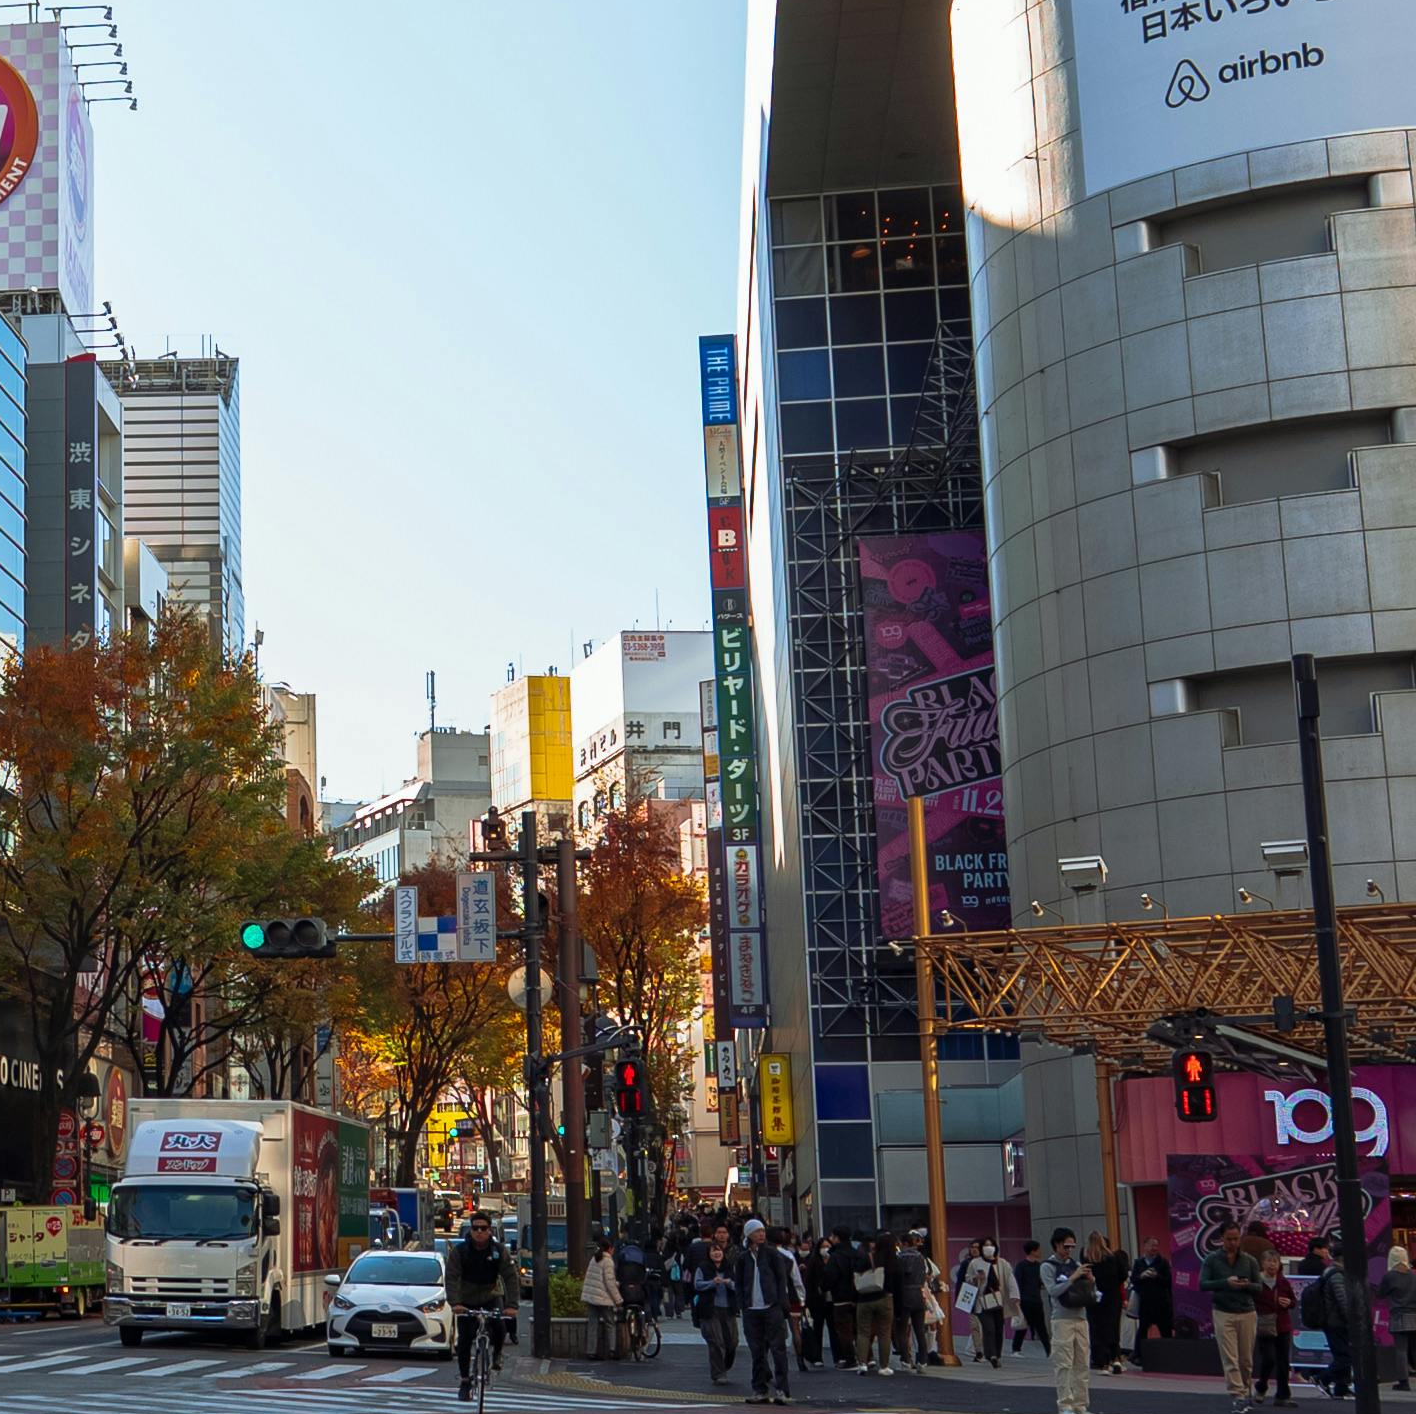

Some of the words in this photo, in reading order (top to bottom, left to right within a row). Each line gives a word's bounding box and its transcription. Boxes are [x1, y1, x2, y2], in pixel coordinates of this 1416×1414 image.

[1218, 42, 1325, 84] airbnb
[706, 346, 730, 374] THE
[708, 376, 732, 421] PRIME
[721, 627, 750, 824] ビリヤード・ダーツ
[732, 828, 750, 842] 3F
[935, 854, 984, 871] BLACK
[734, 860, 752, 915] カラオケ
[399, 889, 413, 961] スクランブル式
[472, 879, 490, 954] 道玄坂下
[740, 1005, 756, 1015] 4F
[10, 1060, 64, 1092] CINES
